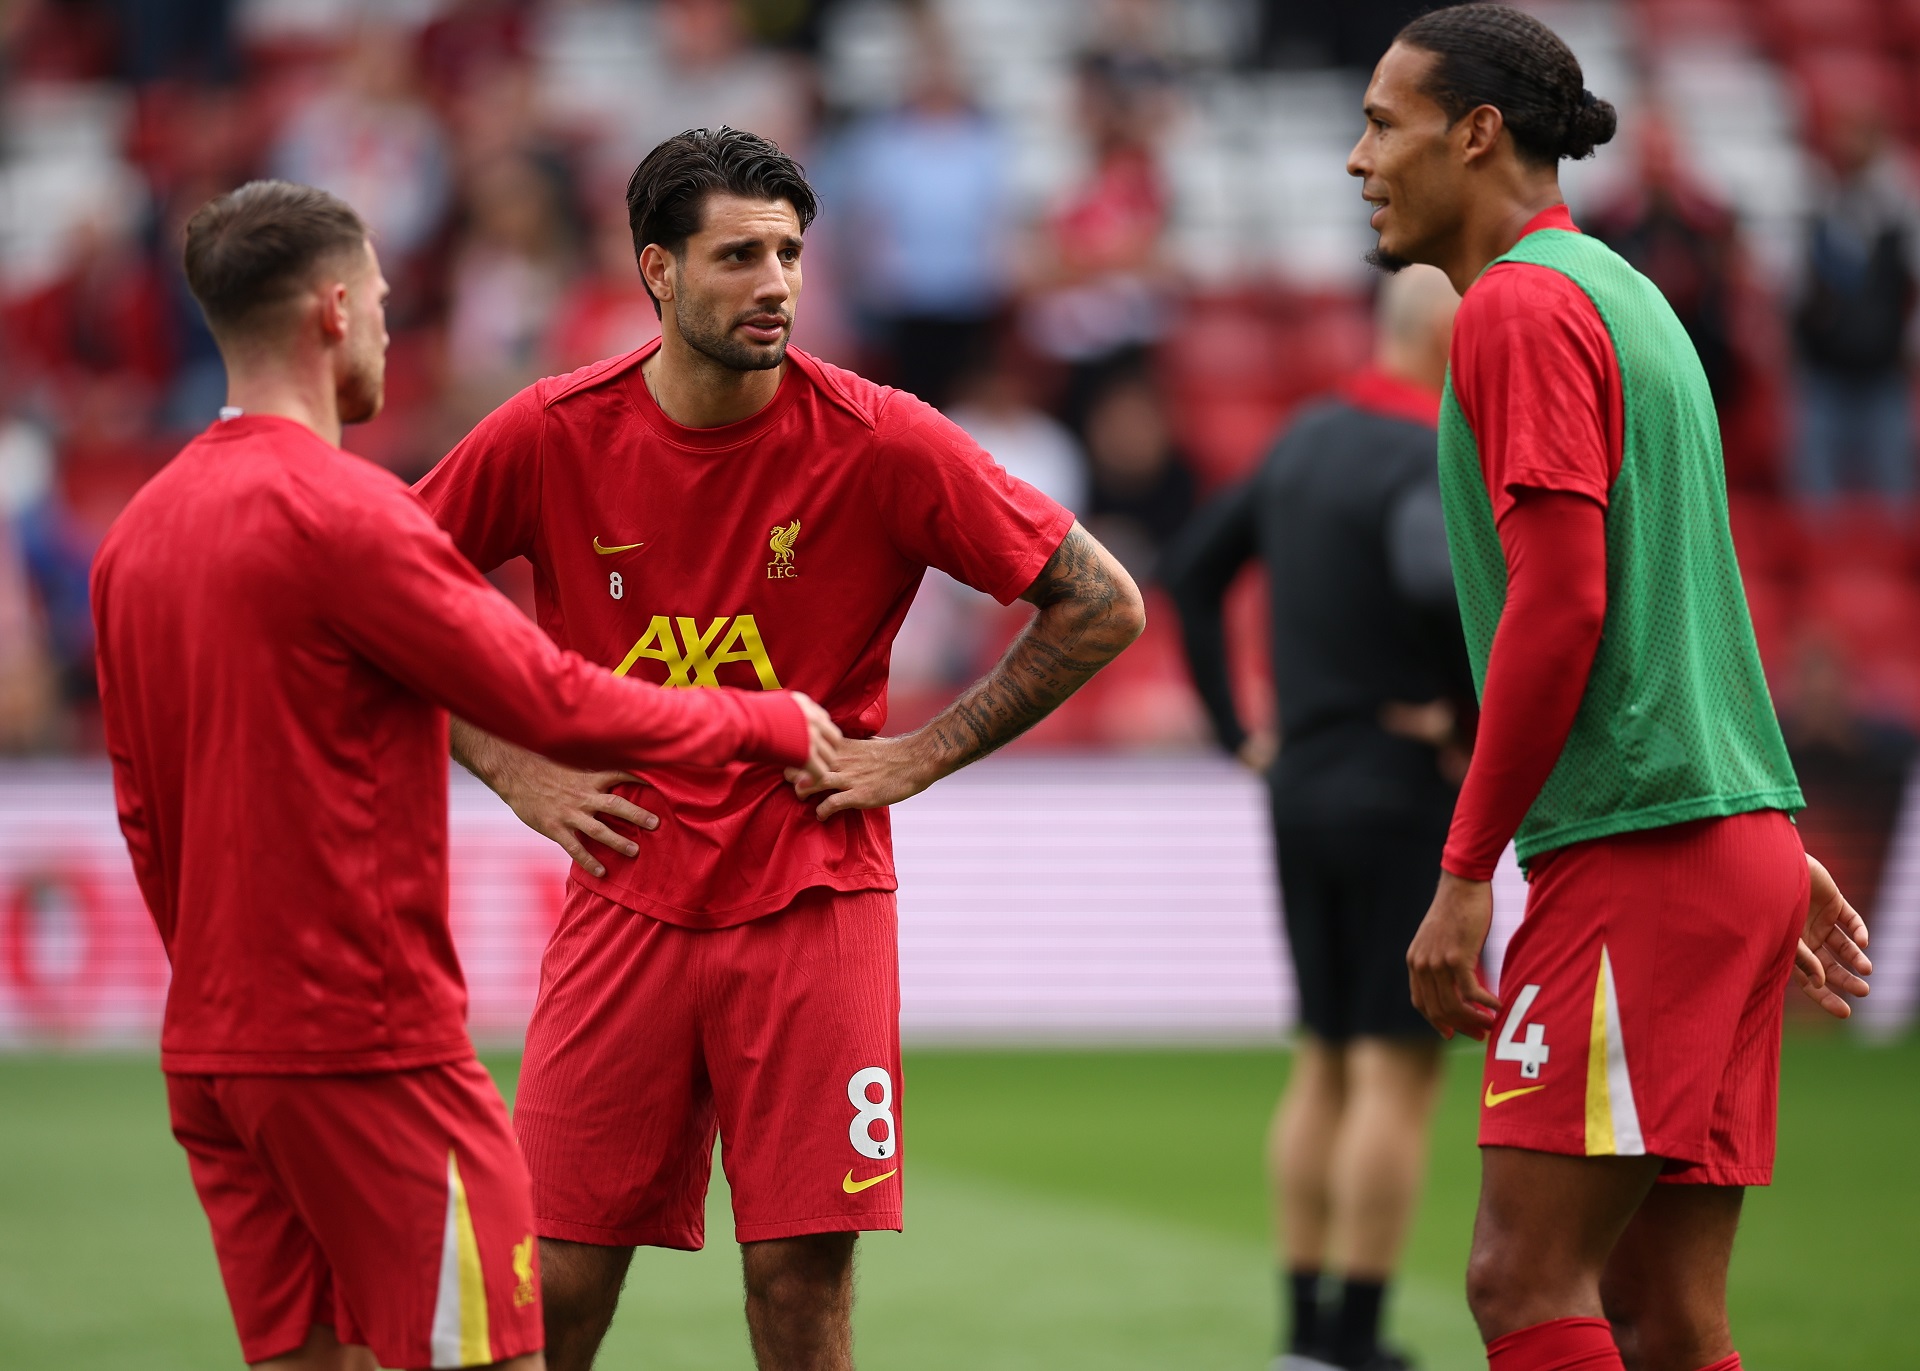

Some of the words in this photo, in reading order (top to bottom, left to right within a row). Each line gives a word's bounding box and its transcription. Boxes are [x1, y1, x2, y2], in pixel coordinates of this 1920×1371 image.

[609, 571, 623, 600] 8
[767, 566, 798, 579] L.F.C.
[611, 614, 783, 690] AXA
[1495, 984, 1550, 1079] 4
[847, 1066, 896, 1160] 8
